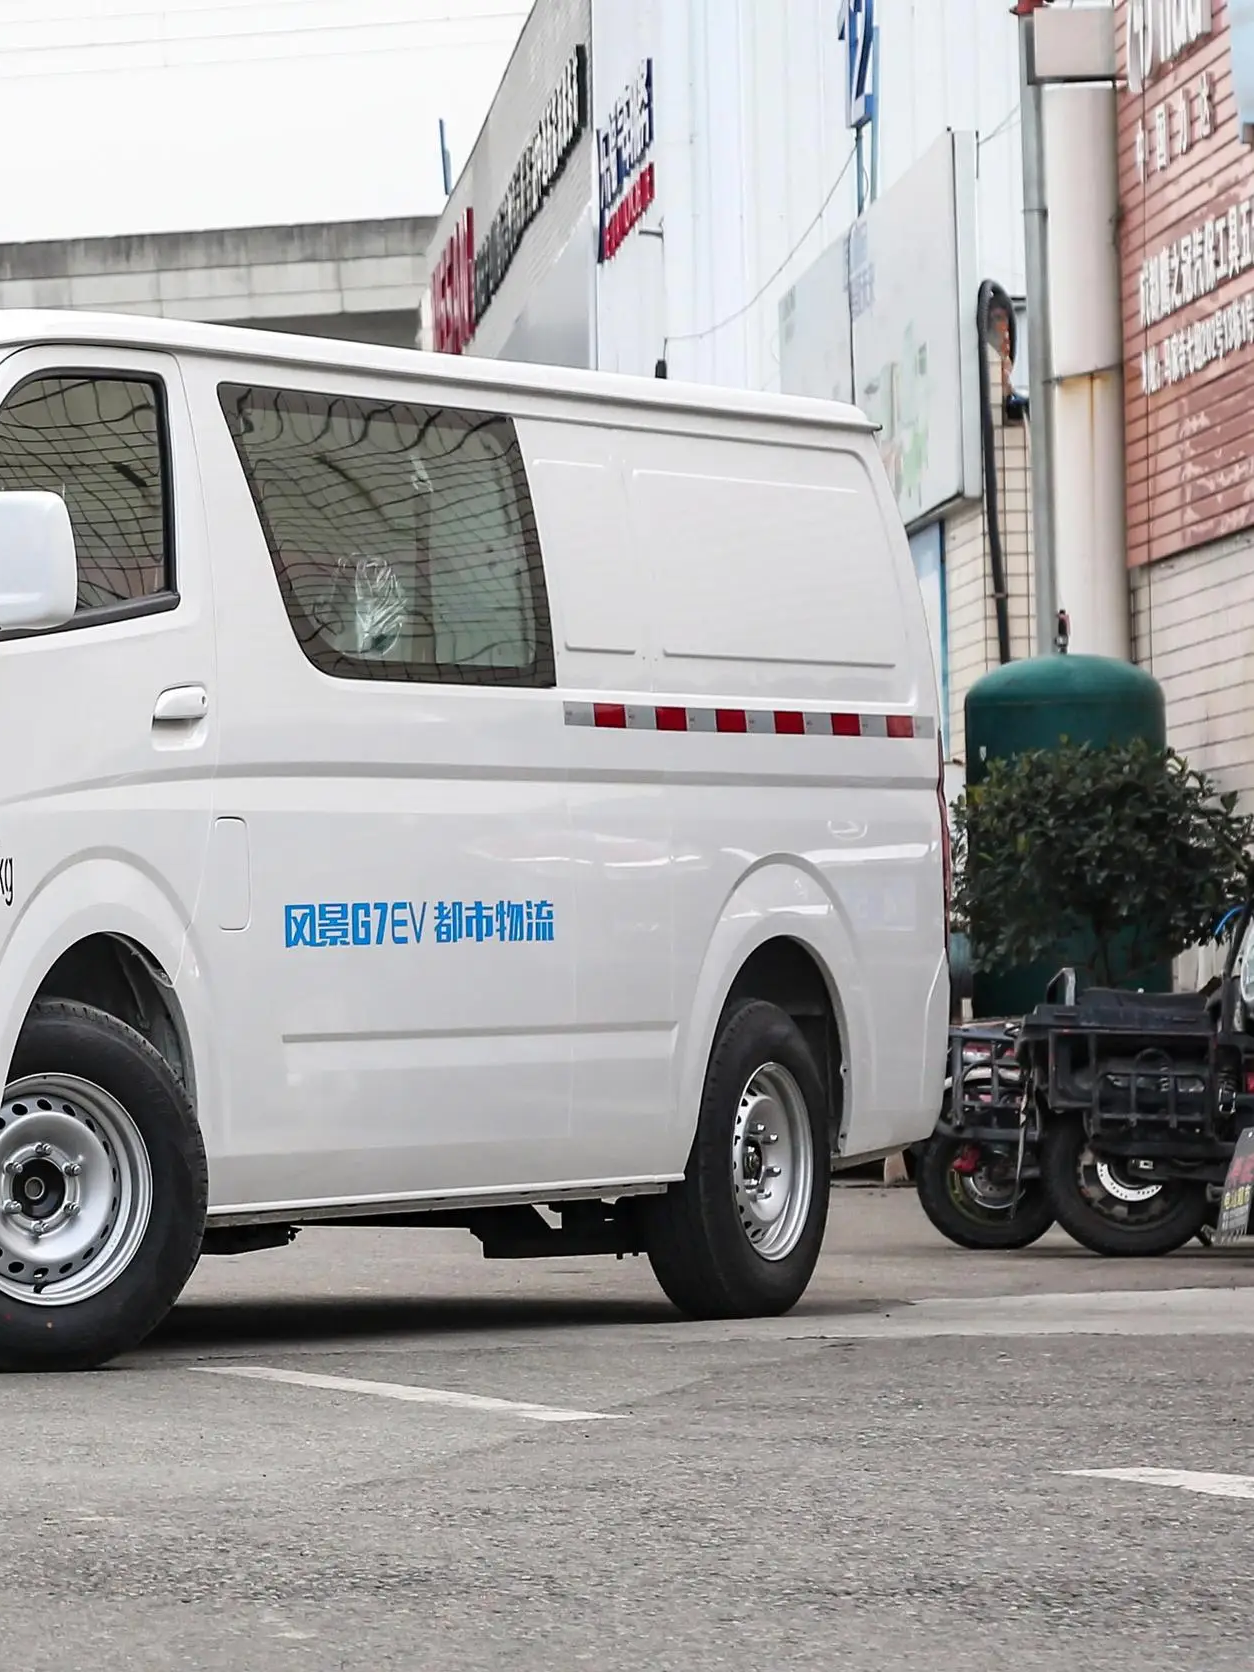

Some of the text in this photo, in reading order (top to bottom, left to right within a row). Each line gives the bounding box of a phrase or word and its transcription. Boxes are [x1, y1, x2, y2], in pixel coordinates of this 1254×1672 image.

[284, 900, 554, 948] 风景G7EV 都市物流
